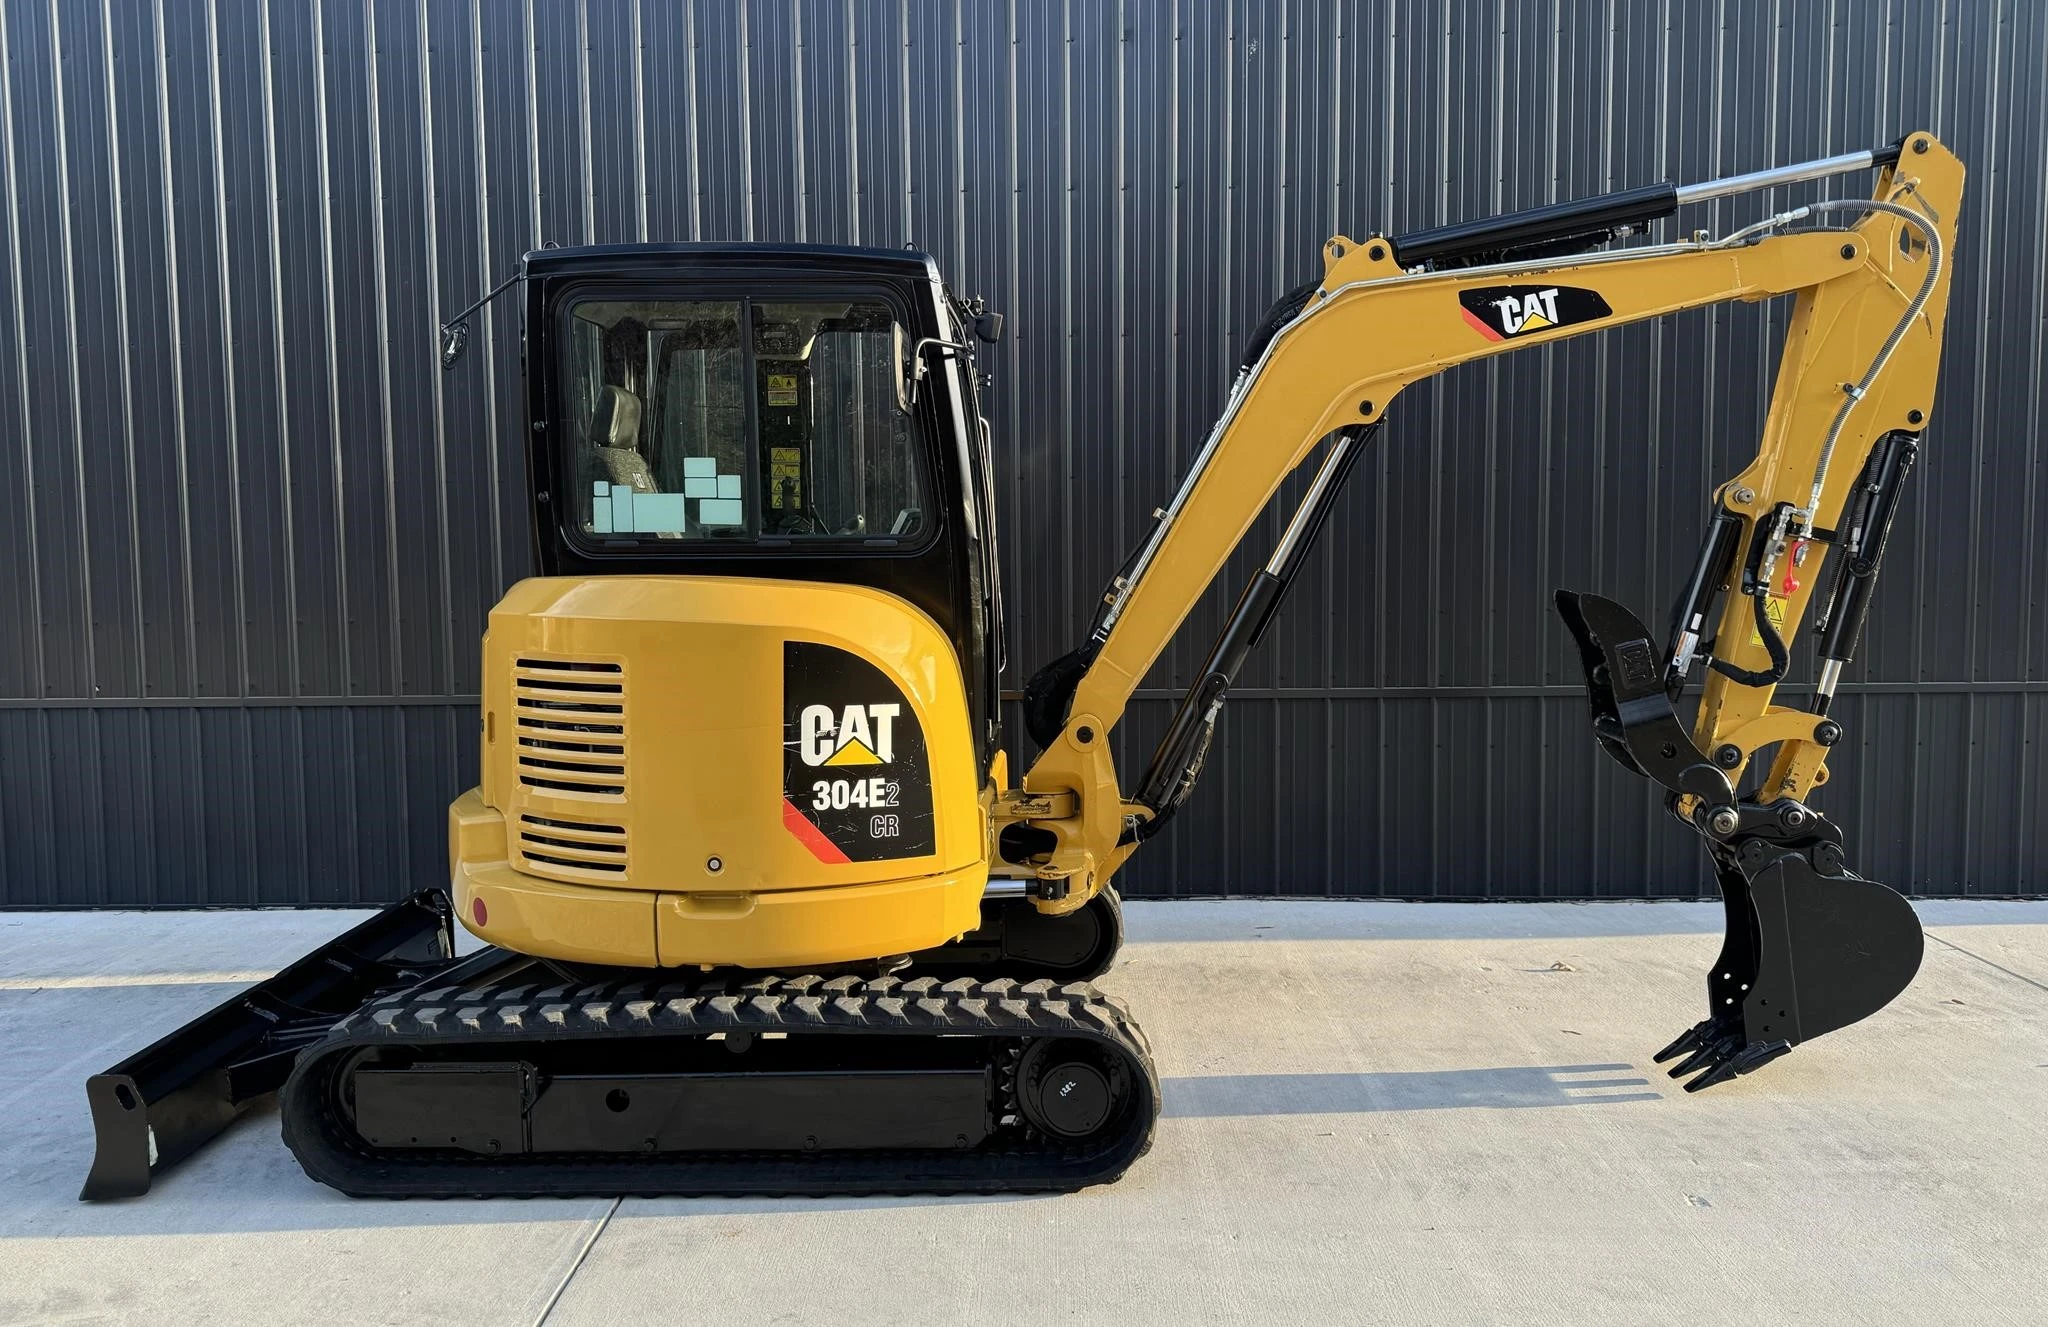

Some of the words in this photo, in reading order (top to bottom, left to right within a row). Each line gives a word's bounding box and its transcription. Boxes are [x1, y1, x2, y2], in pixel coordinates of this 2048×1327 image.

[1500, 288, 1559, 334] CAT
[801, 703, 900, 767] CAT
[812, 778, 900, 811] 304E2
[870, 814, 900, 839] CR
